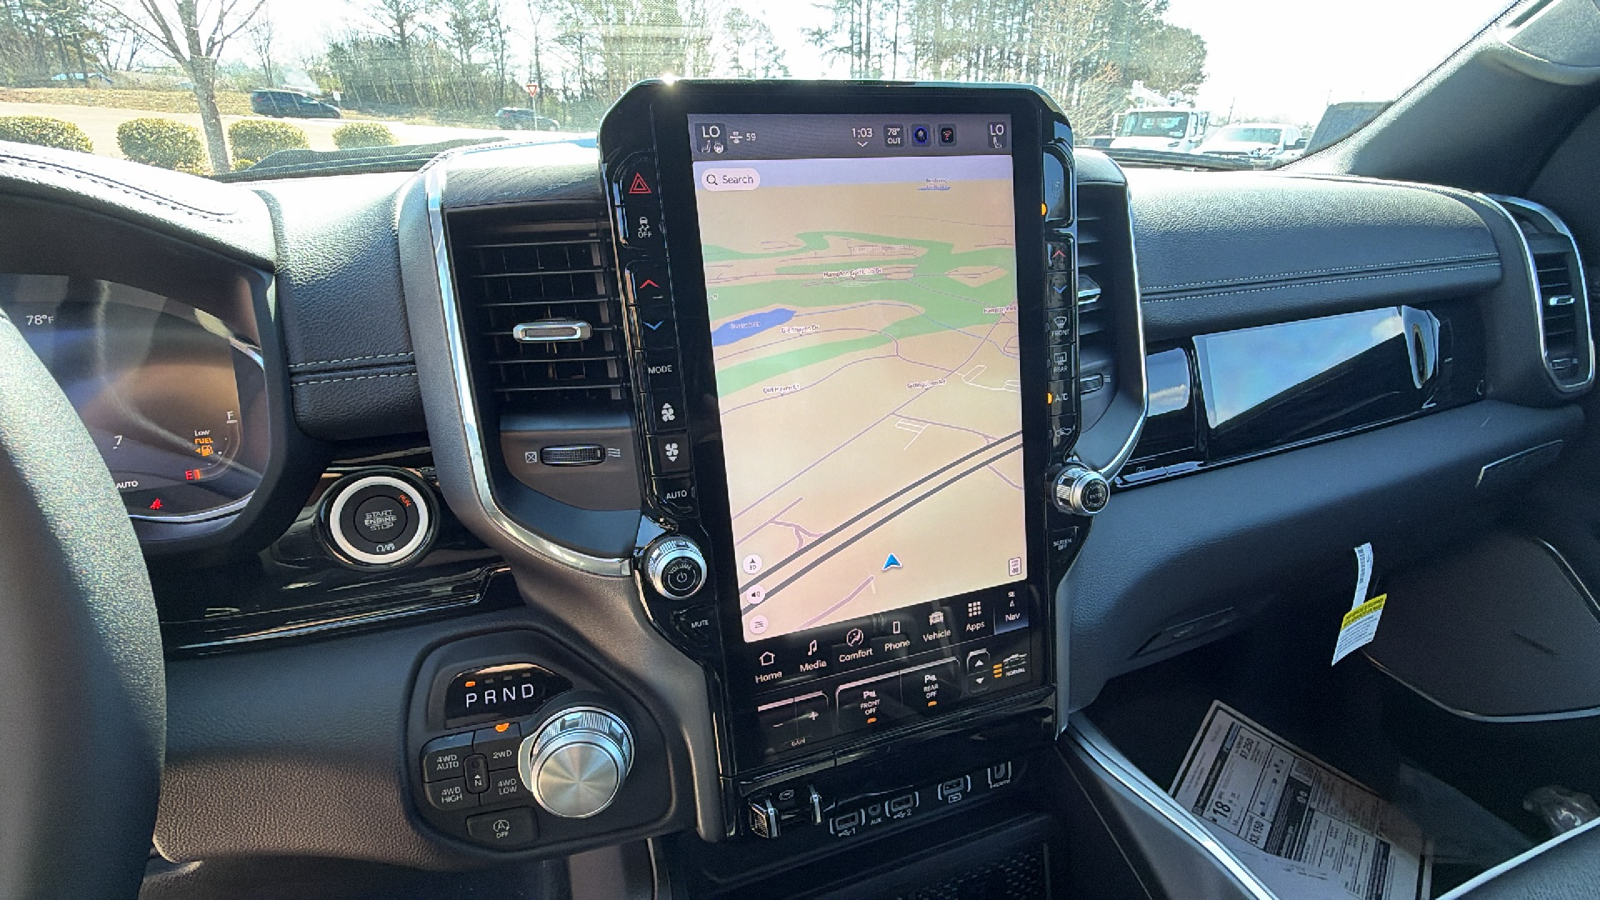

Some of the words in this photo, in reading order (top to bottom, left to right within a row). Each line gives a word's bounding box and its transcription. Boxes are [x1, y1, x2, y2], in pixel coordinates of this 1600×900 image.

[702, 125, 720, 138] LO
[852, 127, 873, 138] 1:03
[990, 124, 1005, 136] LO
[746, 132, 757, 141] 59
[722, 174, 754, 185] Search
[1052, 329, 1070, 337] FRONT
[648, 364, 673, 374] MODE
[185, 471, 194, 481] E
[666, 490, 688, 500] AUTO
[365, 510, 394, 519] START
[364, 515, 398, 526] ENGINE
[370, 523, 394, 531] STOP
[668, 563, 693, 574] VOLUME
[1005, 613, 1021, 622] Nav
[691, 619, 710, 628] MUTE
[966, 622, 986, 632] Apps
[922, 629, 952, 642] Vehicle
[884, 640, 911, 651] Phone
[839, 648, 873, 662] Comfort
[800, 660, 827, 672] Media
[755, 671, 783, 683] Home
[923, 683, 939, 692] REAR
[926, 690, 937, 699] OFF
[860, 699, 881, 709] FRONT
[865, 707, 877, 715] OFF
[436, 754, 458, 763] 4WD
[493, 749, 513, 758] 2WD
[436, 761, 460, 771] AUTO
[474, 778, 483, 787] N
[497, 778, 517, 787] 4WD
[441, 786, 462, 796] 4WD
[498, 785, 518, 795] LOW
[441, 794, 463, 803] HIGH
[1213, 801, 1231, 818] 18
[496, 831, 509, 839] OFF
